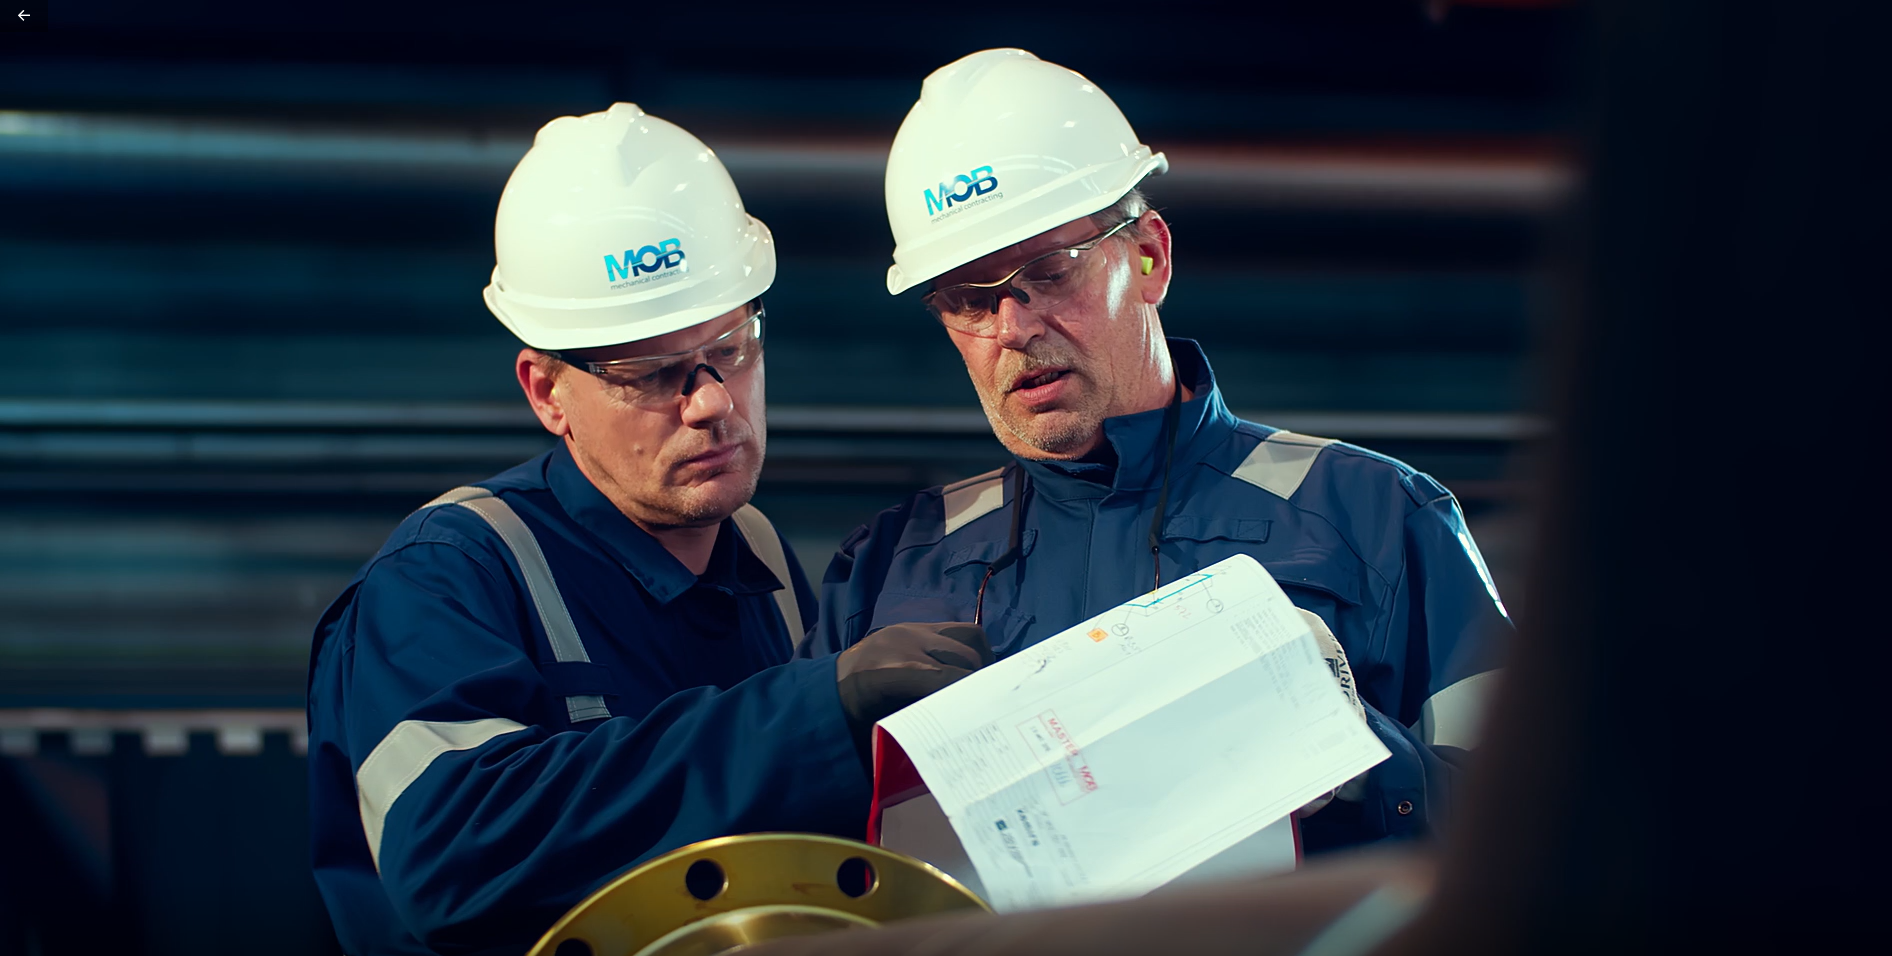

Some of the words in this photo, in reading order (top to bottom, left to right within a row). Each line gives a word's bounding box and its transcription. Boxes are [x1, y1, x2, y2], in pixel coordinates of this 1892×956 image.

[923, 165, 998, 217] MOB
[931, 206, 963, 224] mechanical
[963, 192, 1004, 212] contracting
[603, 237, 686, 282] MOB
[610, 275, 651, 290] mechanical
